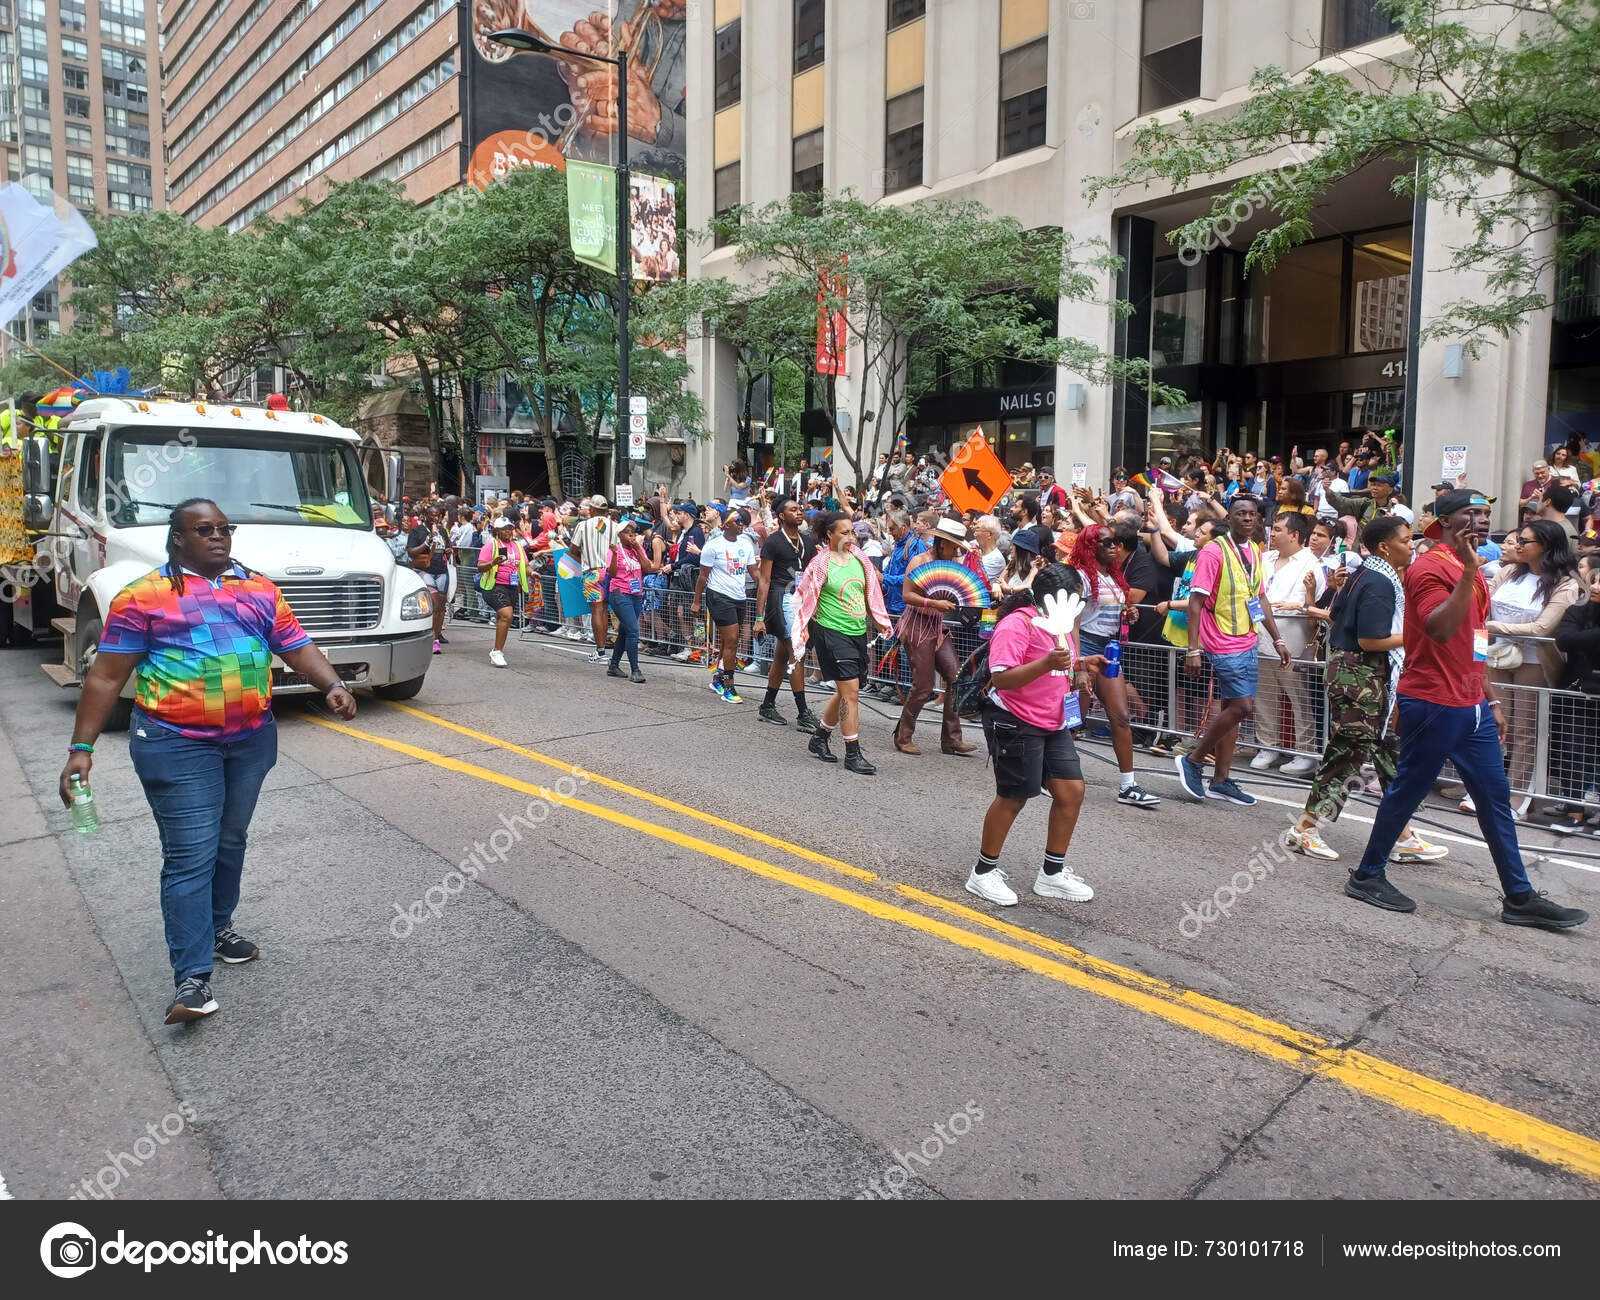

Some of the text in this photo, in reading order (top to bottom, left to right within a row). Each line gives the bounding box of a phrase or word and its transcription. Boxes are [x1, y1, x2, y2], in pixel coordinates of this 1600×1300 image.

[581, 203, 604, 214] MEET
[574, 236, 604, 247] HEART
[1000, 392, 1042, 411] NAILS
